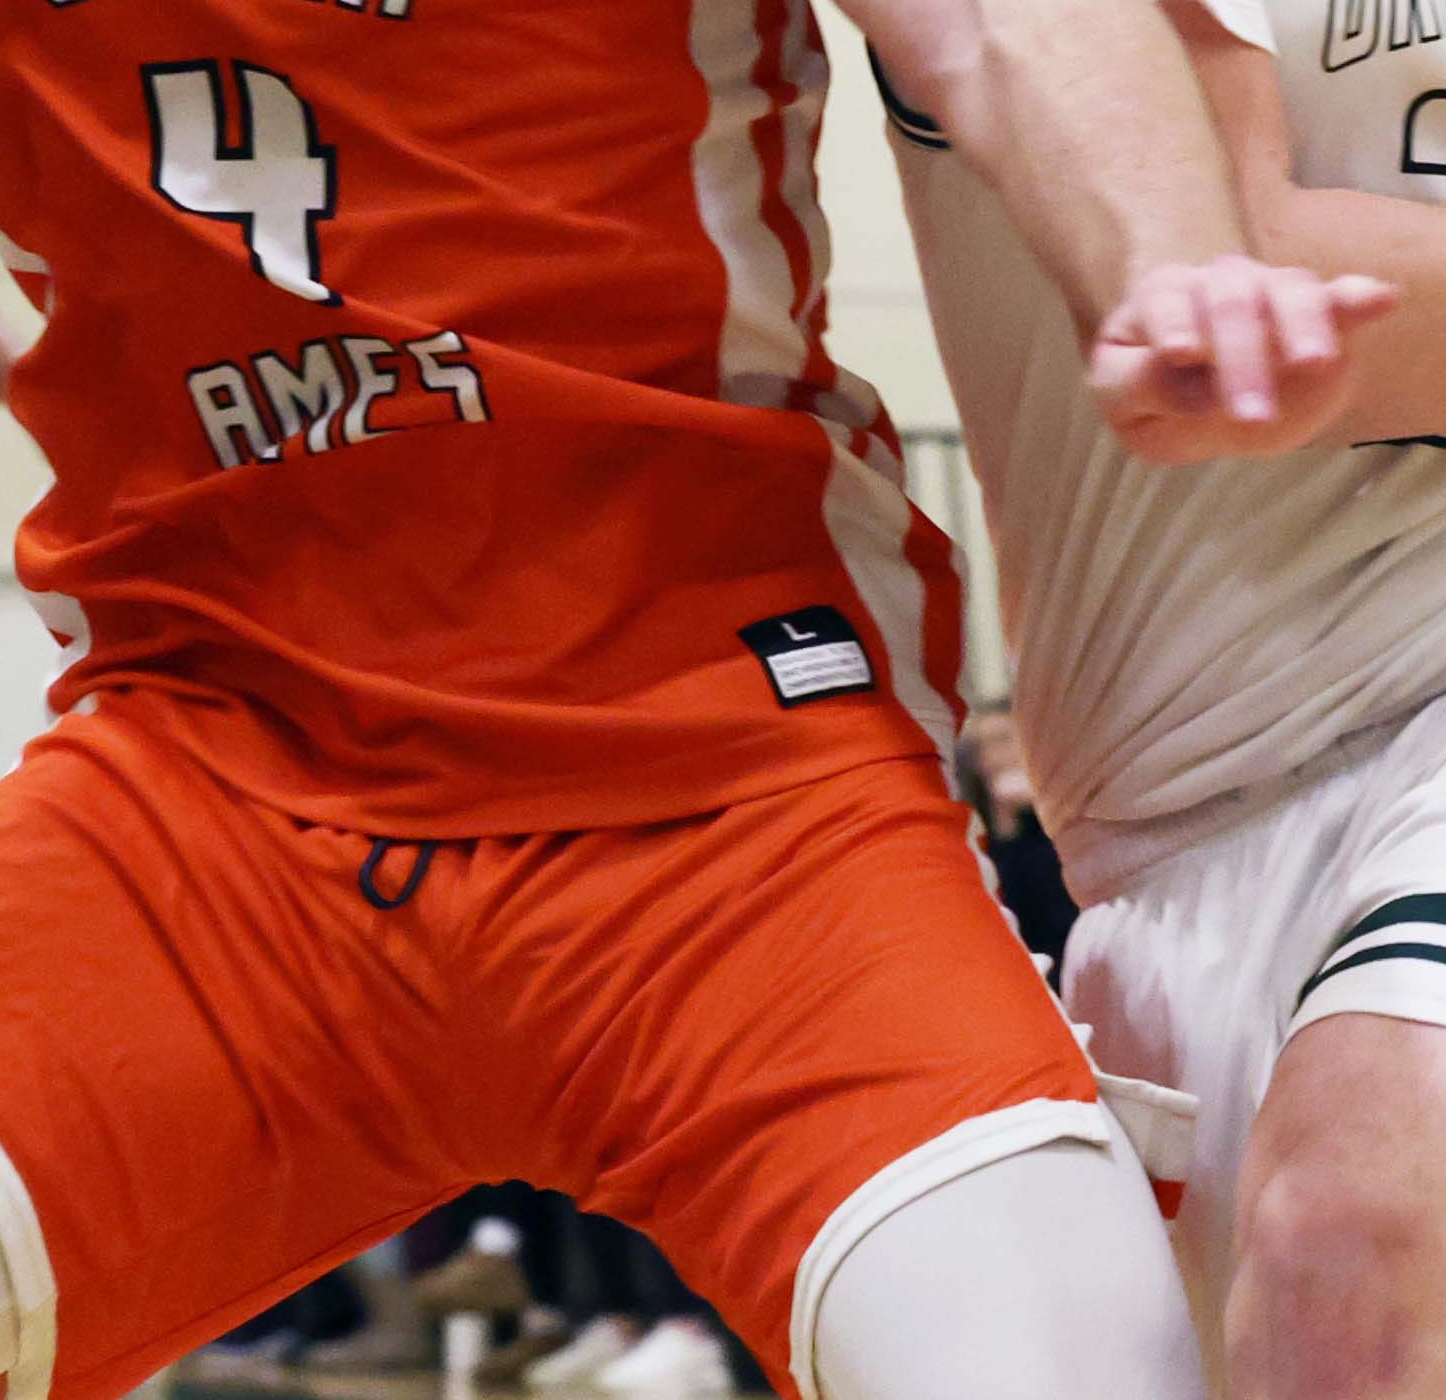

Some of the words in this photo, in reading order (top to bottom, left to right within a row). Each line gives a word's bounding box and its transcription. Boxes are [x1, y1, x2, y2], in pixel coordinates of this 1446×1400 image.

[141, 59, 342, 306] 4
[187, 329, 492, 470] AMES
[780, 621, 817, 642] L
